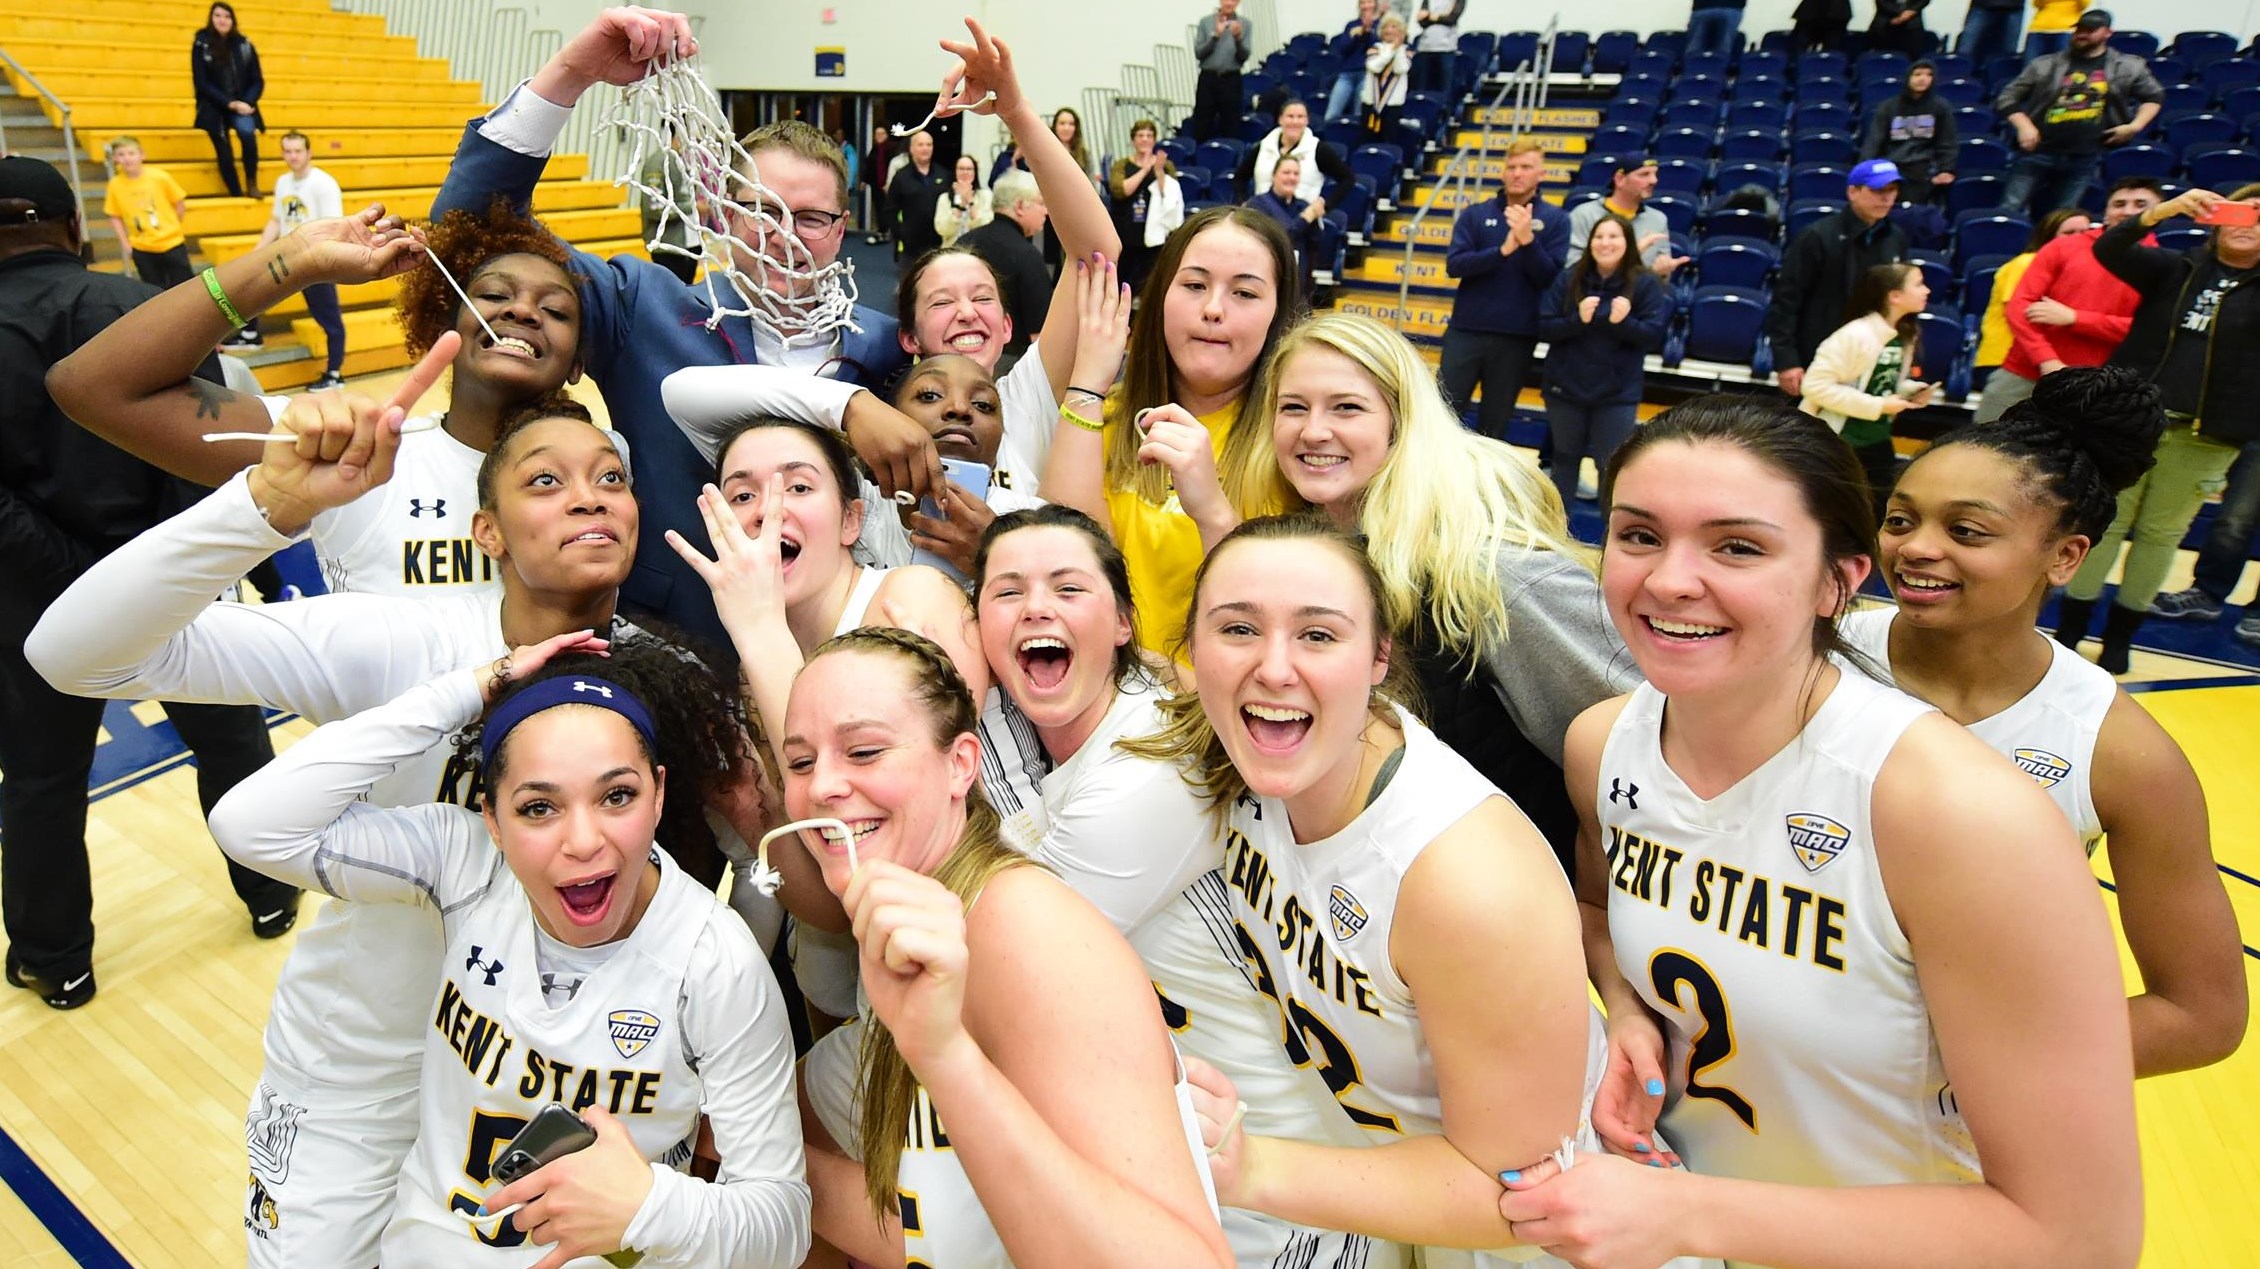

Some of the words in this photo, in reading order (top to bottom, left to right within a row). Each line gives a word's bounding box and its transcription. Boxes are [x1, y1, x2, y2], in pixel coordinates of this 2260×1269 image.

[1395, 264, 1437, 277] KNT
[2016, 756, 2067, 779] MAC
[1787, 827, 1847, 853] MAC
[1330, 895, 1366, 932] MAC
[1689, 859, 1847, 972] STATE
[1277, 895, 1383, 1018] STATE
[434, 980, 512, 1088] KENT
[518, 1048, 662, 1117] STATE
[609, 1022, 659, 1040] MAC
[1649, 947, 1760, 1135] 2
